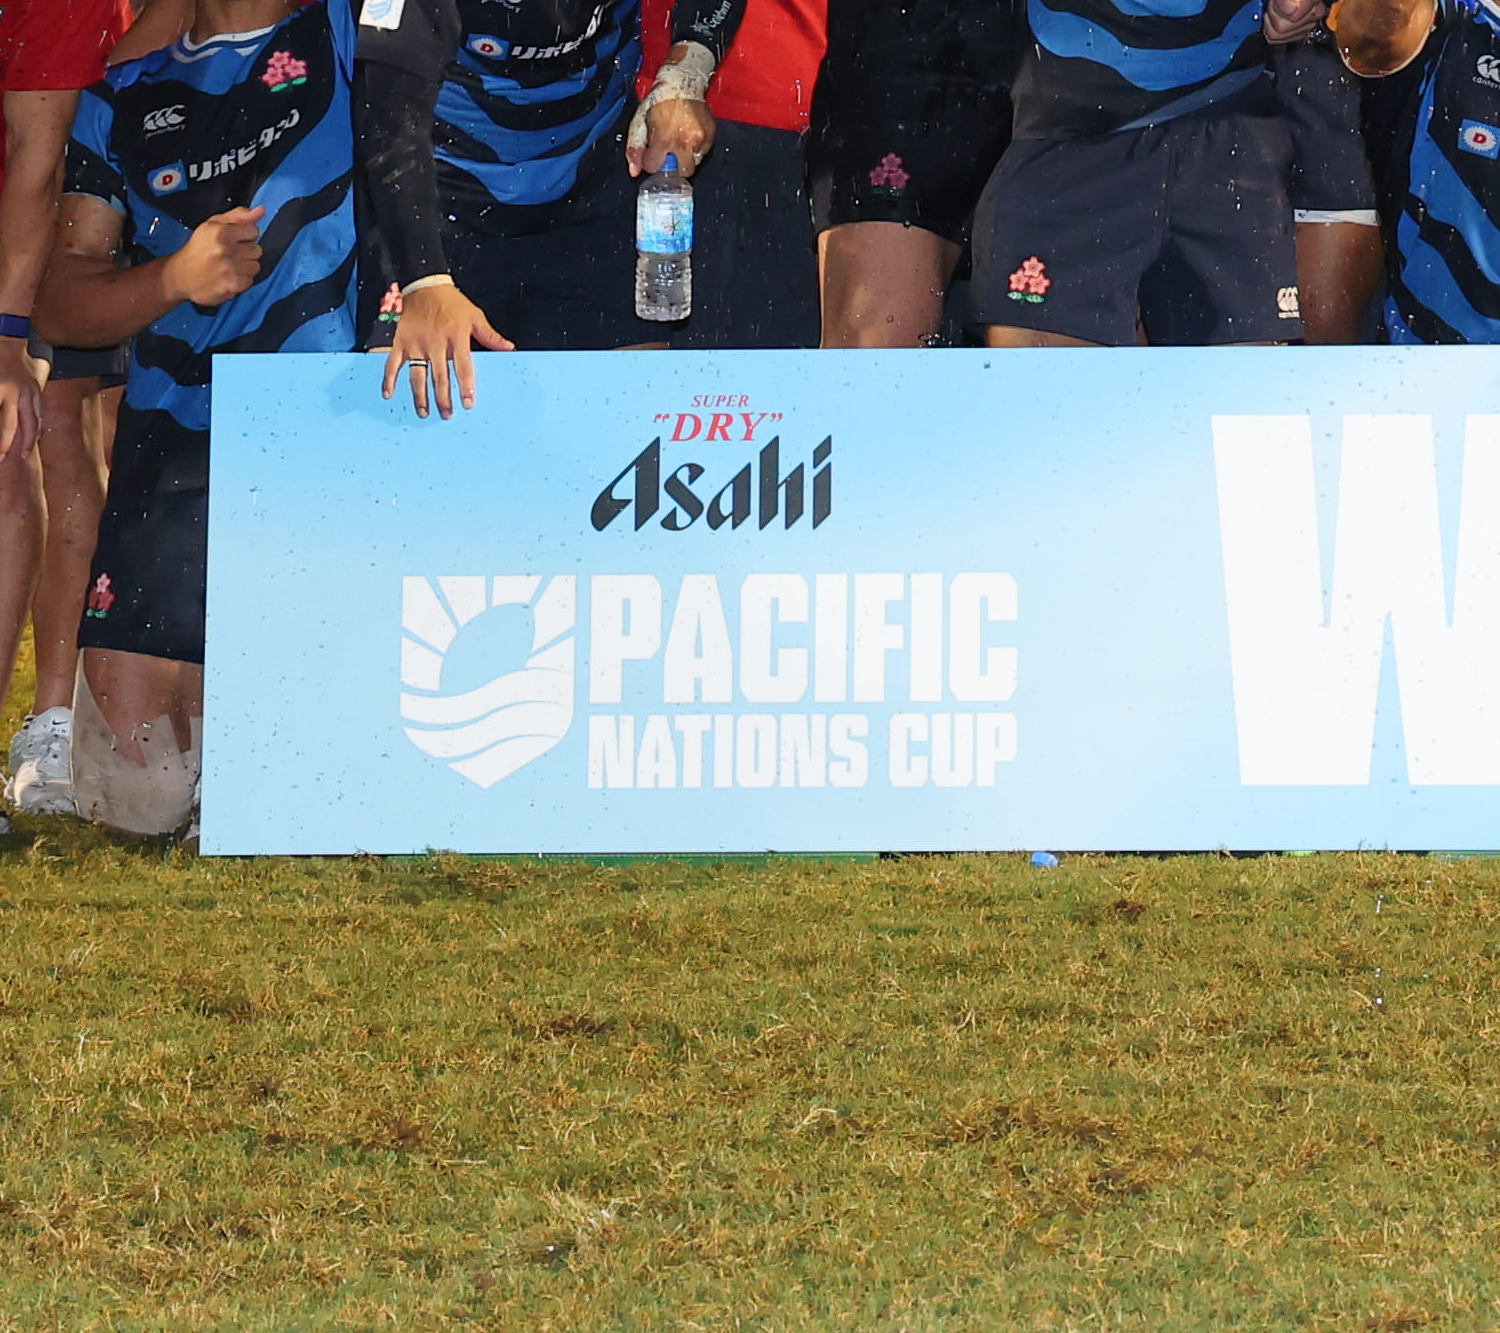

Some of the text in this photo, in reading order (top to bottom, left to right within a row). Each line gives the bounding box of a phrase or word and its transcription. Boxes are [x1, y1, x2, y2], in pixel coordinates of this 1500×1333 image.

[691, 393, 750, 408] SUPER
[590, 434, 833, 531] Asahi
[589, 572, 1018, 703] PACIFIC
[587, 712, 1018, 788] NATIONS CUP
